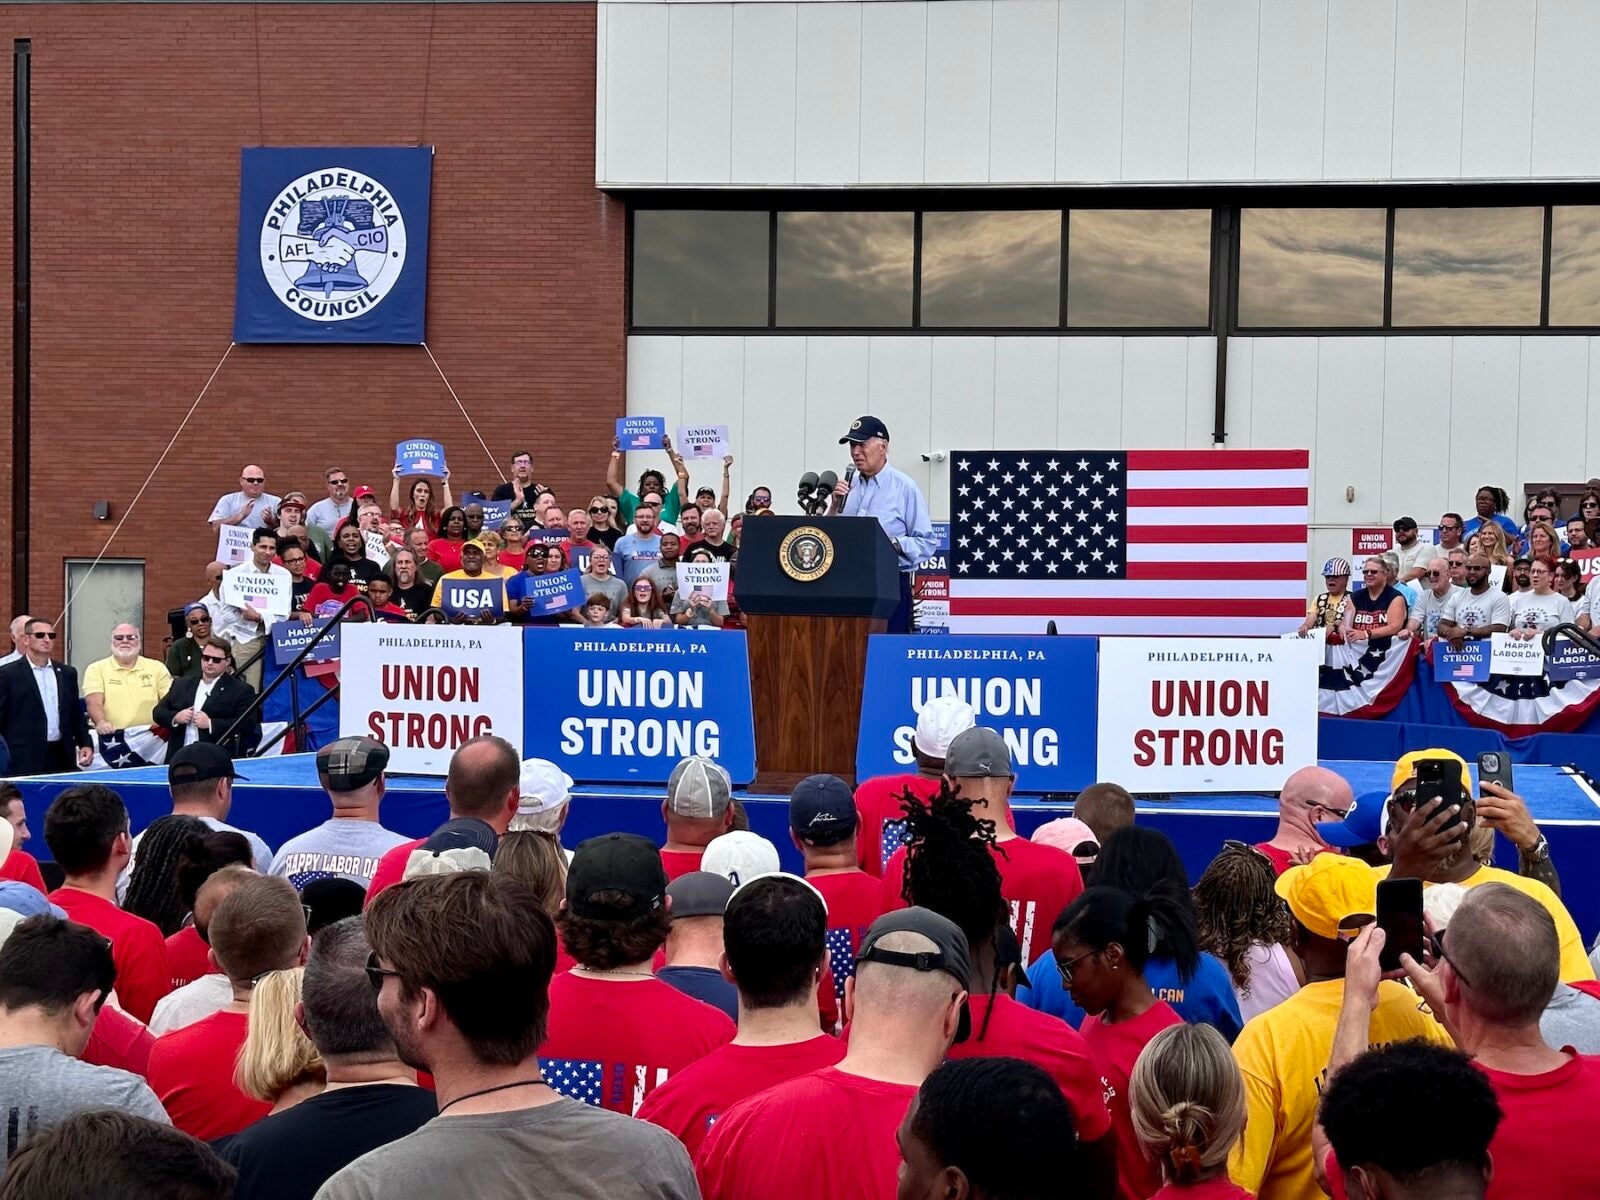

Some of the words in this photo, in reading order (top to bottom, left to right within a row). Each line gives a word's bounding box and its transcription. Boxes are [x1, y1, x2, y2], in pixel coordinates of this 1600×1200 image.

[267, 172, 399, 231] PHILADELPHIA
[284, 244, 314, 258] AFL
[285, 287, 379, 317] COUNCIL
[626, 419, 655, 427] UNION
[622, 426, 658, 434] STRONG
[687, 428, 718, 436] UNION
[684, 436, 721, 444] STRONG
[405, 442, 436, 451] UNION
[402, 450, 439, 460] STRONG
[228, 529, 249, 539] UNION
[1361, 533, 1385, 541] UNION
[1358, 541, 1388, 549] STRONG
[687, 566, 720, 575] UNION
[237, 576, 275, 586] UNION
[534, 575, 569, 588] UNION
[684, 575, 722, 583] STRONG
[233, 584, 279, 595] STRONG
[532, 582, 574, 598] STRONG
[450, 588, 494, 608] USA
[378, 637, 466, 650] PHILADELPHIA,
[468, 638, 483, 649] PA
[573, 641, 687, 655] PHILADELPHIA,
[690, 643, 708, 654] PA
[1504, 641, 1535, 650] HAPPY
[907, 648, 1024, 662] PHILADELPHIA,
[1027, 650, 1046, 661] PA
[1147, 651, 1254, 664] PHILADELPHIA,
[1257, 652, 1274, 663] PA
[1442, 654, 1483, 663] STRONG
[1492, 649, 1524, 658] LABOR
[1525, 650, 1542, 658] DAY
[1552, 655, 1586, 664] LABOR
[381, 663, 480, 703] UNION
[578, 667, 704, 708] UNION
[1151, 679, 1270, 718] UNION
[560, 716, 721, 758] STRONG
[1133, 727, 1285, 767] STRONG
[285, 853, 321, 877] HAPPY
[321, 854, 361, 876] LABOR
[362, 857, 380, 880] DA
[1158, 988, 1185, 1003] CAN
